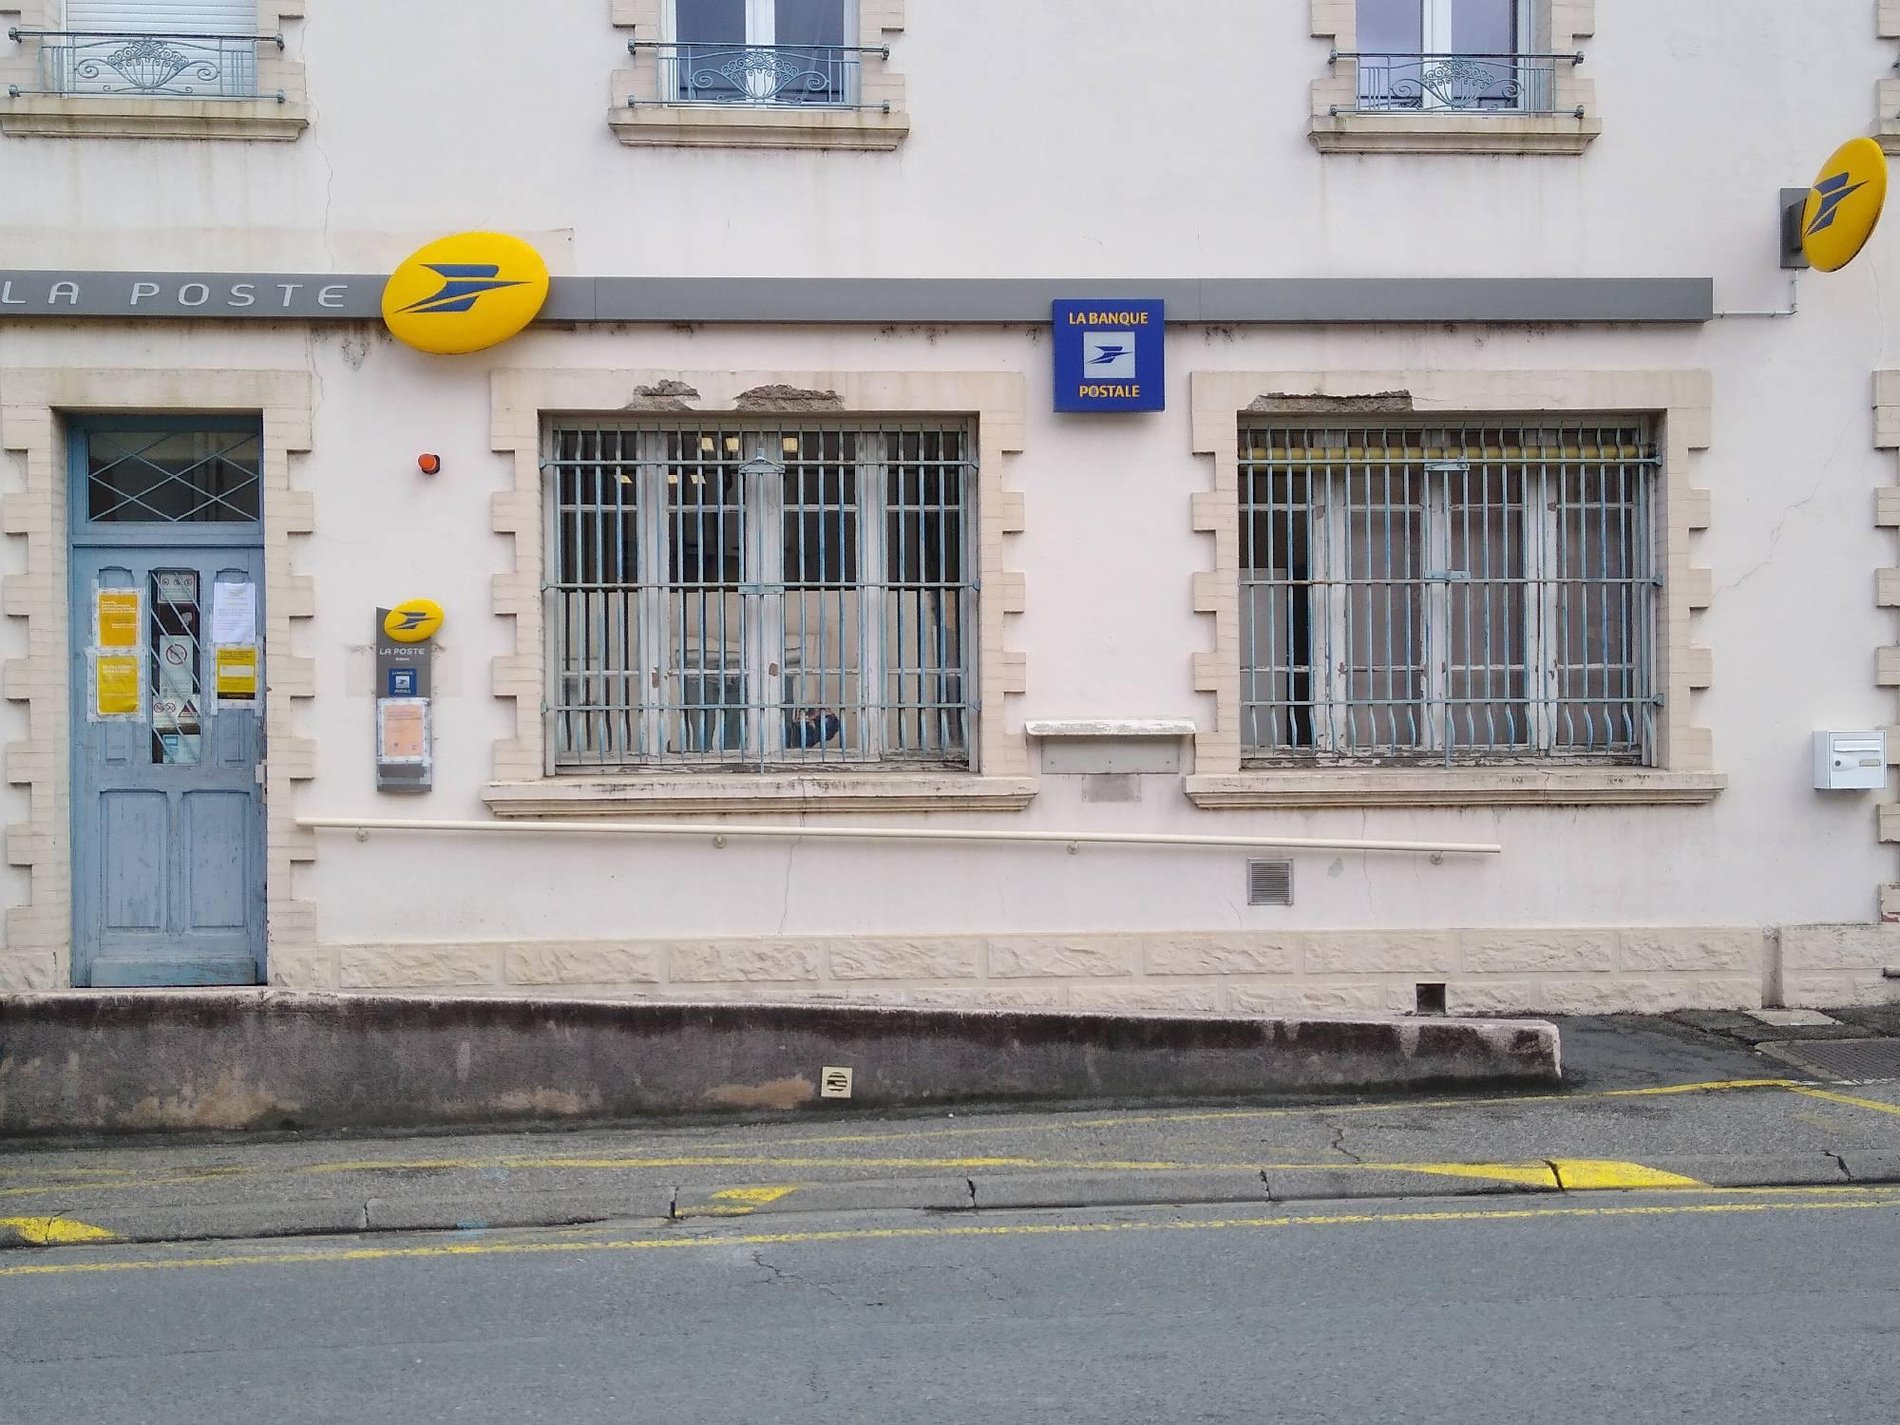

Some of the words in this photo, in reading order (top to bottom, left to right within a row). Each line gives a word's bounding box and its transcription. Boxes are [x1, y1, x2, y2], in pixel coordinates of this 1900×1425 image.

[1, 280, 81, 306] LA
[129, 283, 349, 308] POSTE
[1069, 312, 1086, 325] LA
[1089, 312, 1149, 326] BANQUE
[1079, 385, 1140, 398] POSTALE
[393, 647, 425, 655] POSTE
